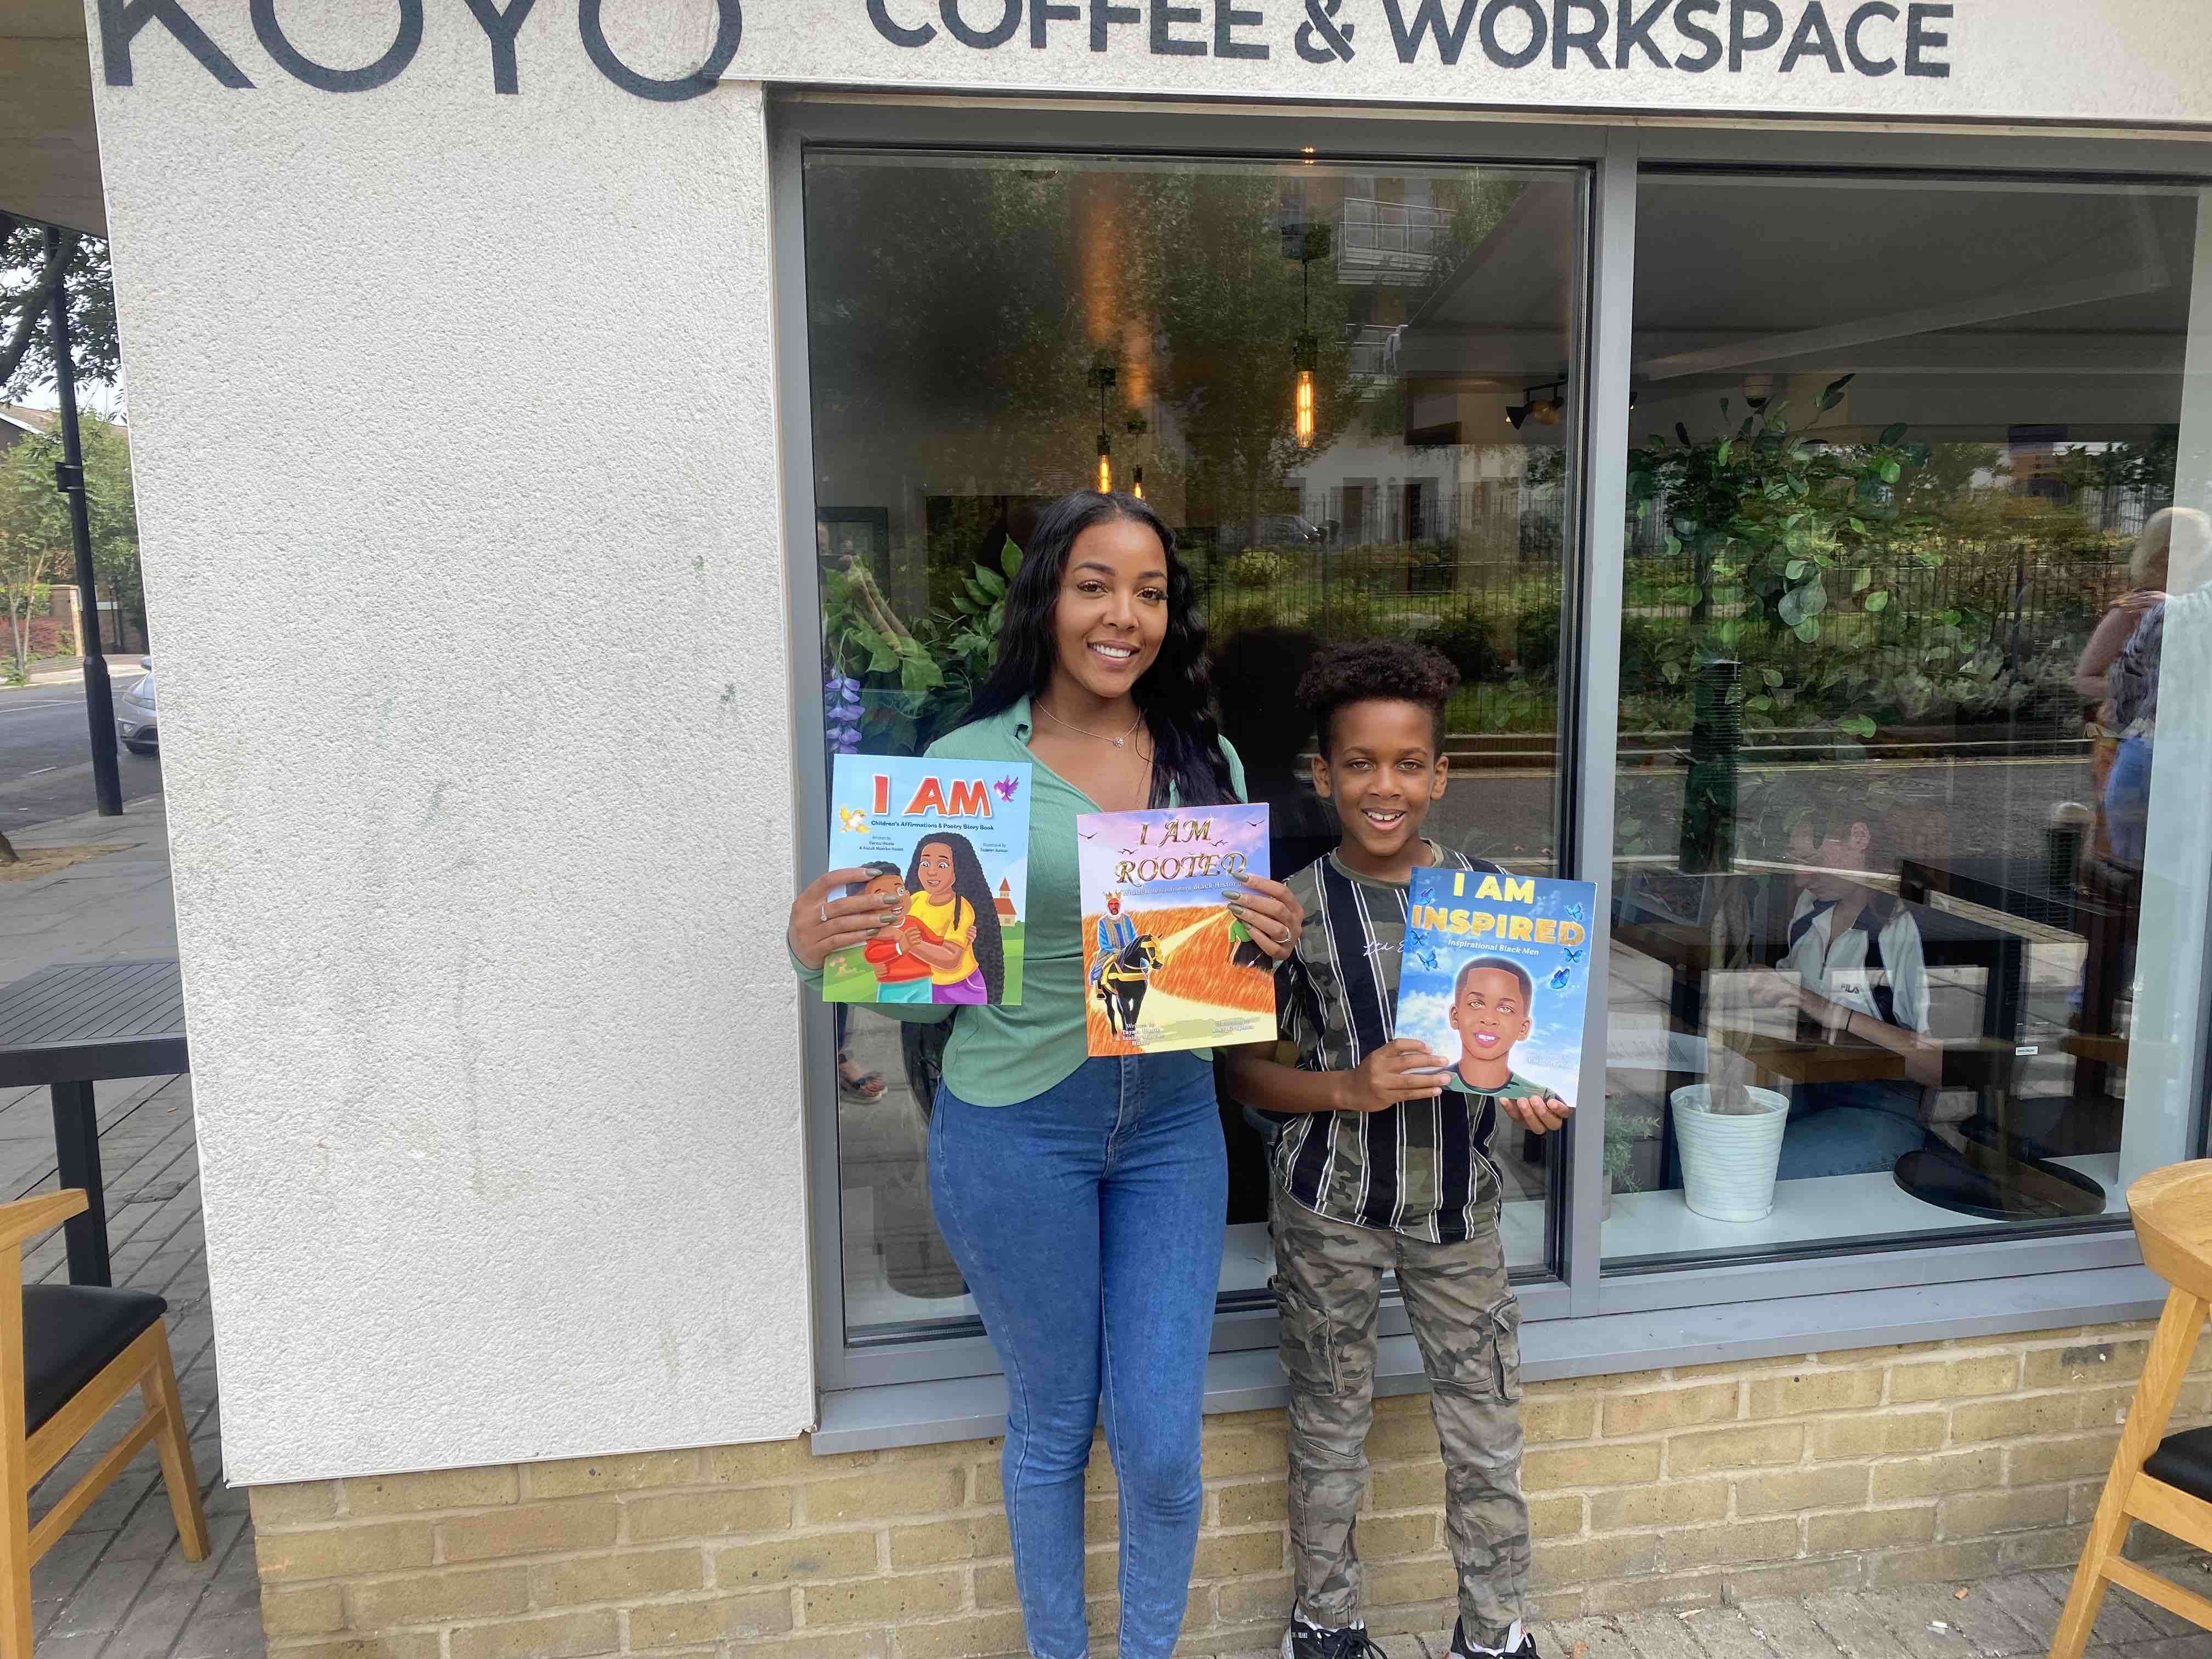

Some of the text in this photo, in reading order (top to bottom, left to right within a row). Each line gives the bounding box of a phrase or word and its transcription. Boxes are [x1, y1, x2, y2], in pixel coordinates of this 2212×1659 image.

[867, 0, 1954, 77] COFFEE & WORKSPACE
[873, 774, 992, 817] I AM
[1137, 818, 1211, 847] I AM
[1115, 852, 1246, 887] ROOTED
[1453, 872, 1535, 904] I AM
[1411, 905, 1585, 946] INSPIRED
[1448, 939, 1539, 956] Inspirational Black Men
[1841, 983, 1860, 994] FILA
